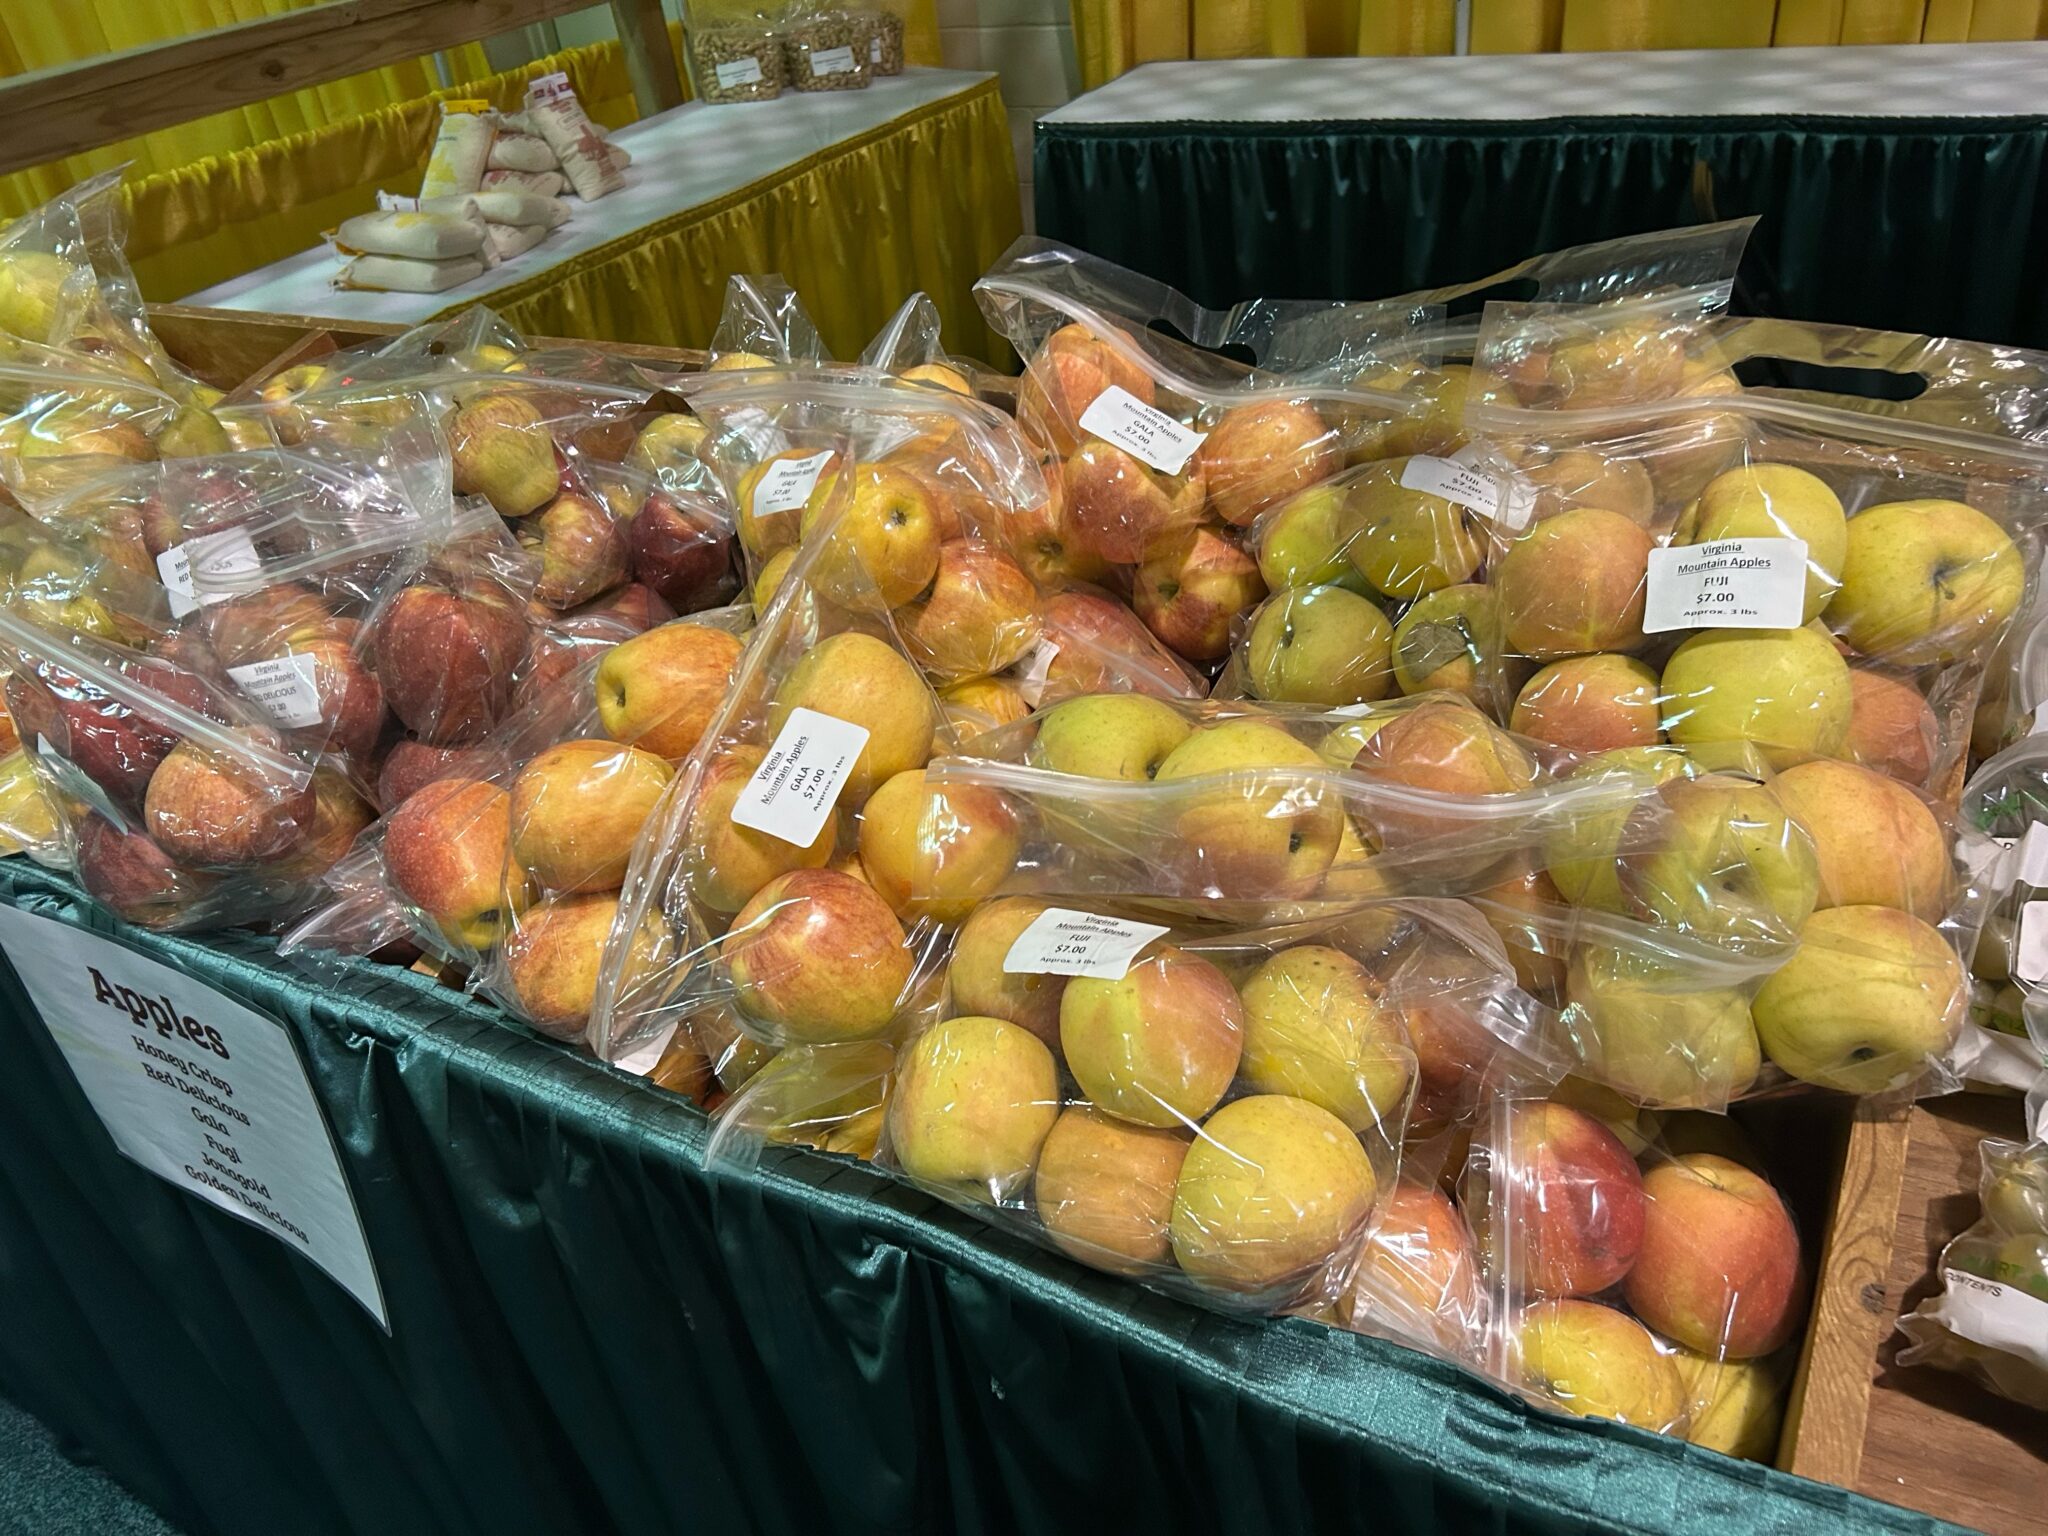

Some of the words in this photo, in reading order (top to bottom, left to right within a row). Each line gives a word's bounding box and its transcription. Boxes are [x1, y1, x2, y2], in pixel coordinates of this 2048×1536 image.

[1125, 426, 1150, 445] $7.00
[1133, 420, 1155, 437] GALA
[1460, 472, 1479, 486] FUJI
[1702, 543, 1742, 555] Virginia
[1677, 558, 1727, 574] Mountain
[1730, 557, 1771, 569] Apples
[1704, 576, 1729, 587] FUJI
[1697, 592, 1734, 604] $7.00
[758, 751, 783, 781] Virginia
[761, 765, 790, 804] Mountain
[786, 735, 808, 765] Apples
[790, 767, 810, 792] GALA
[803, 769, 825, 799] $7.00
[1056, 922, 1099, 931] Mountain
[1055, 944, 1087, 954] $7.00
[87, 966, 230, 1060] Apples
[131, 1035, 190, 1075] Honey
[188, 1061, 233, 1097] Crisp
[142, 1062, 178, 1089] Red
[175, 1076, 250, 1126] Delicious
[191, 1106, 230, 1136] Gala
[201, 1151, 272, 1200] Jonagold
[184, 1164, 241, 1201] Golden
[239, 1191, 309, 1244] Delicious
